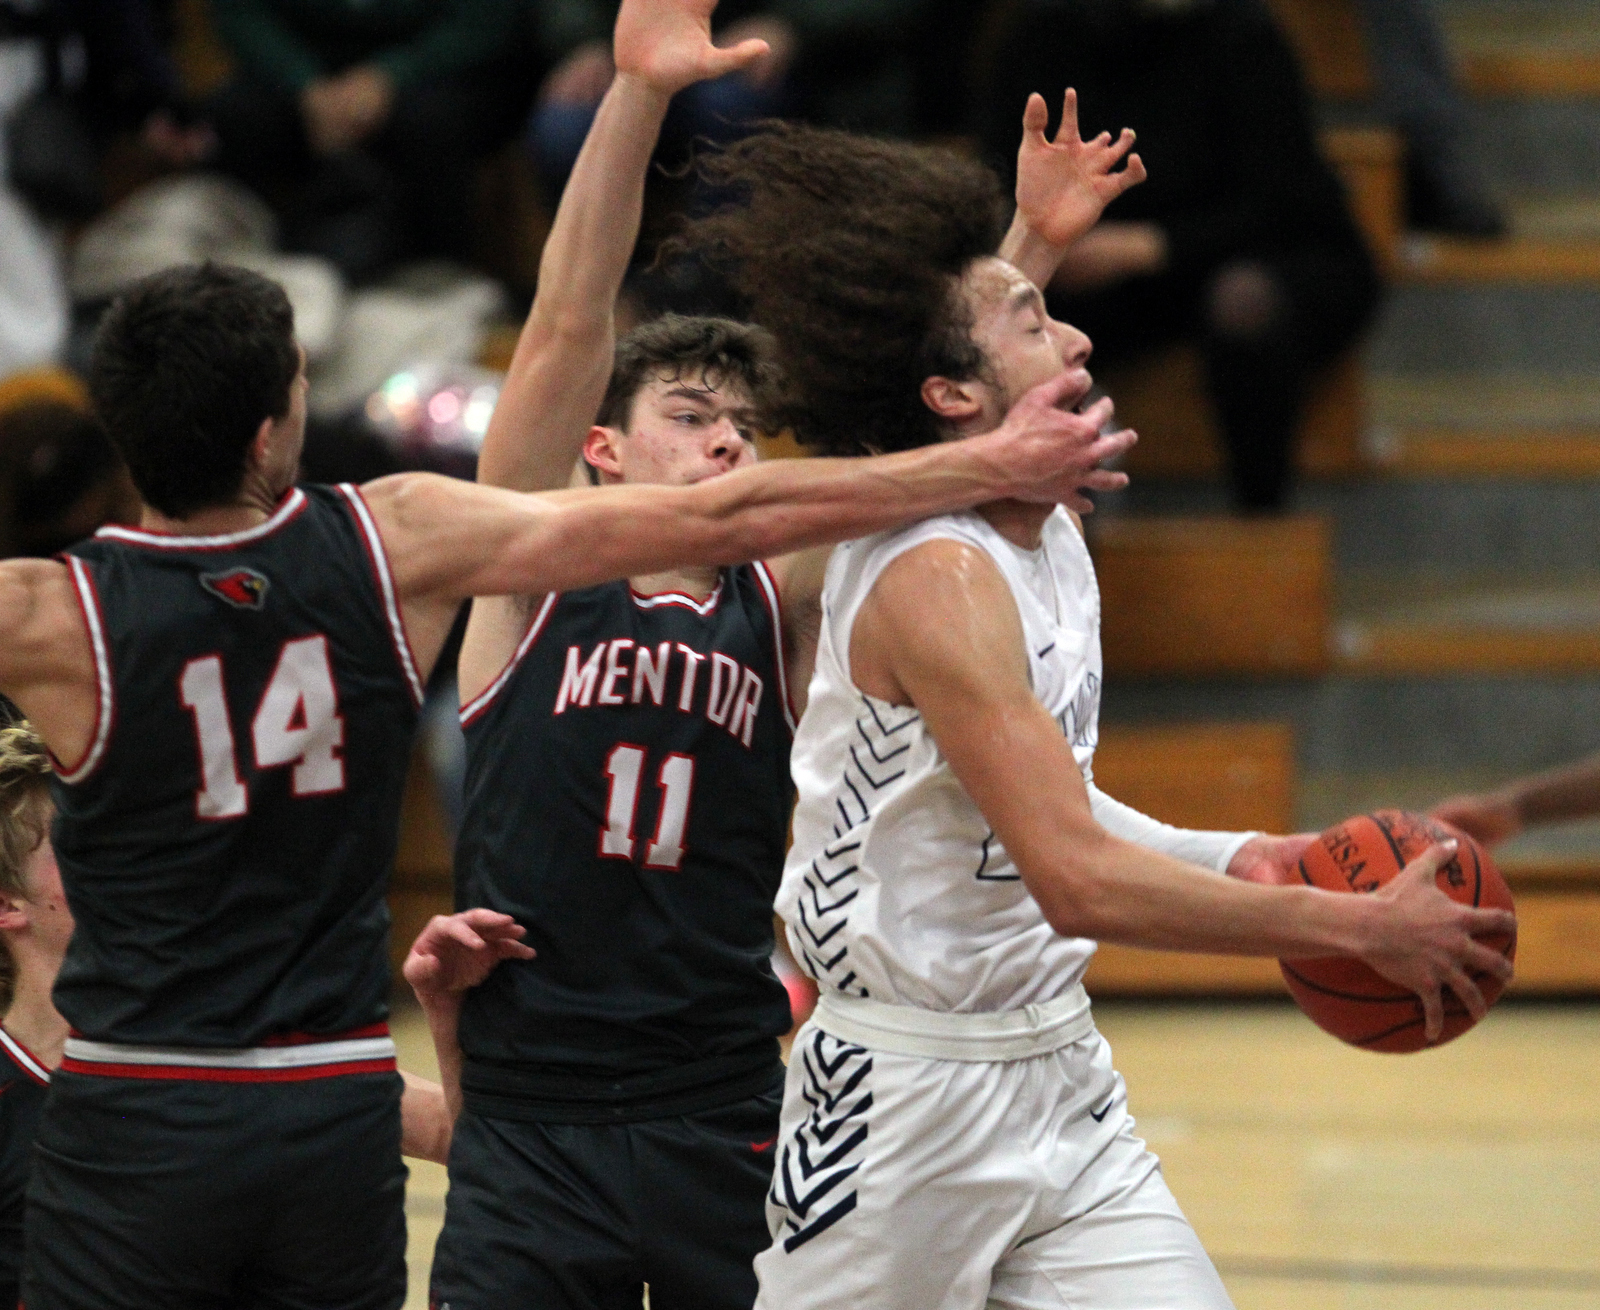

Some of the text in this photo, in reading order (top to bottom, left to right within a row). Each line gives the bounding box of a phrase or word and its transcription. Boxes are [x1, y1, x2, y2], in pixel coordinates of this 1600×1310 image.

[177, 633, 346, 820] 14
[553, 637, 764, 749] MENTOR
[597, 741, 695, 871] 11
